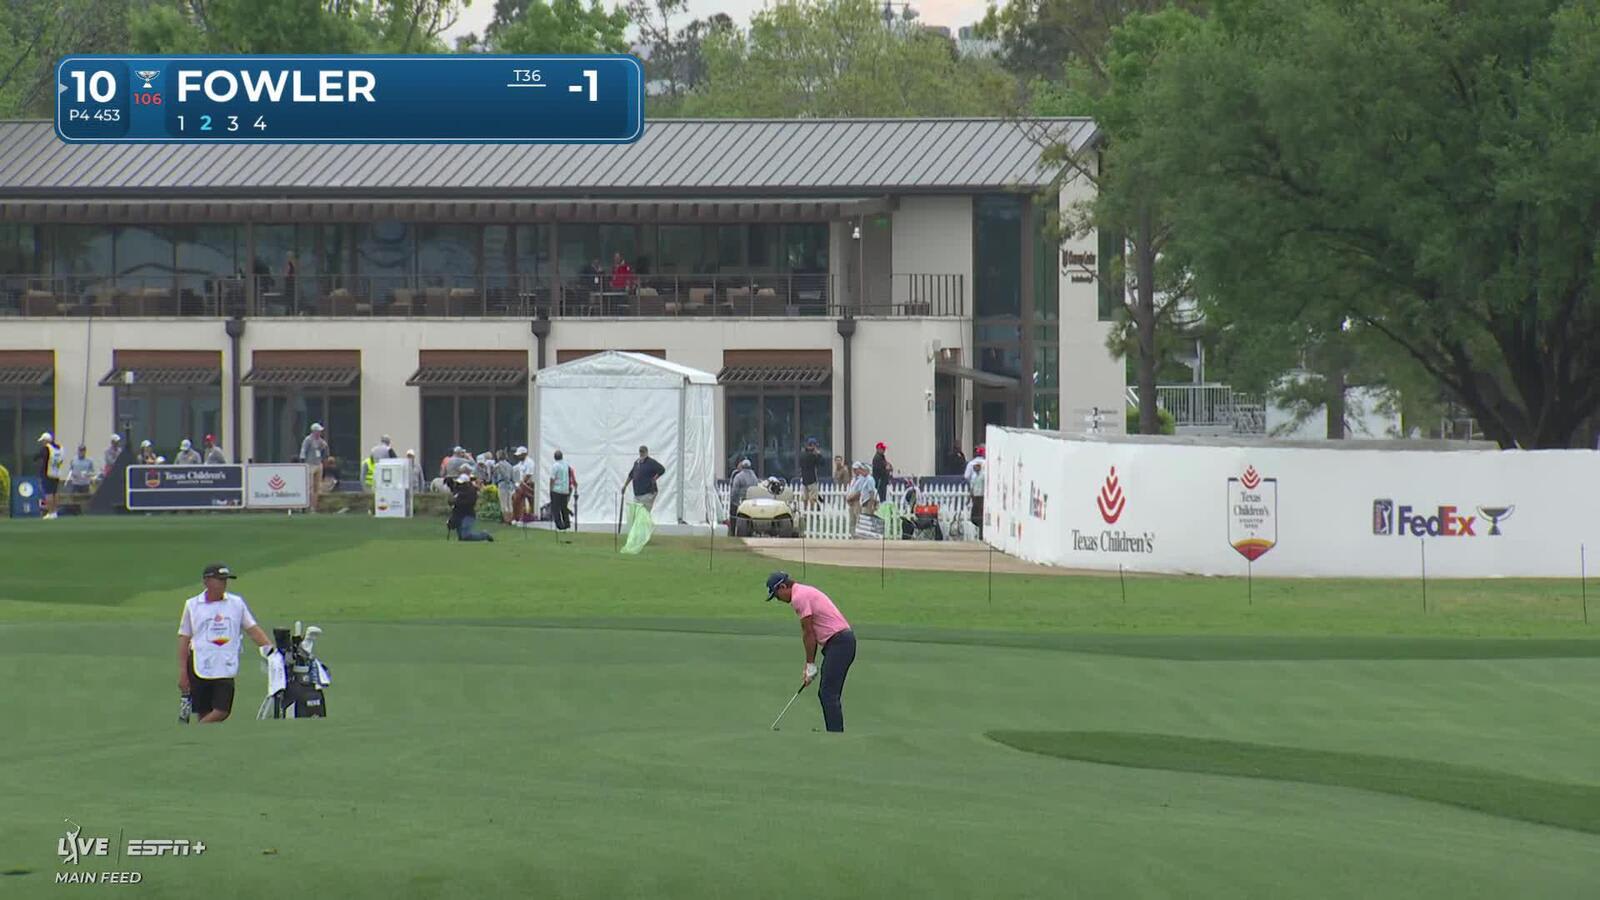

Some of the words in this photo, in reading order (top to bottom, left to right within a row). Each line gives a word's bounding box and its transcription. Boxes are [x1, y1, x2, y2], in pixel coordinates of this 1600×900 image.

[165, 471, 186, 481] Texas
[1241, 492, 1262, 503] Texas
[1398, 505, 1477, 537] FedEx
[1071, 529, 1099, 552] Texas
[1099, 530, 1154, 554] Children's
